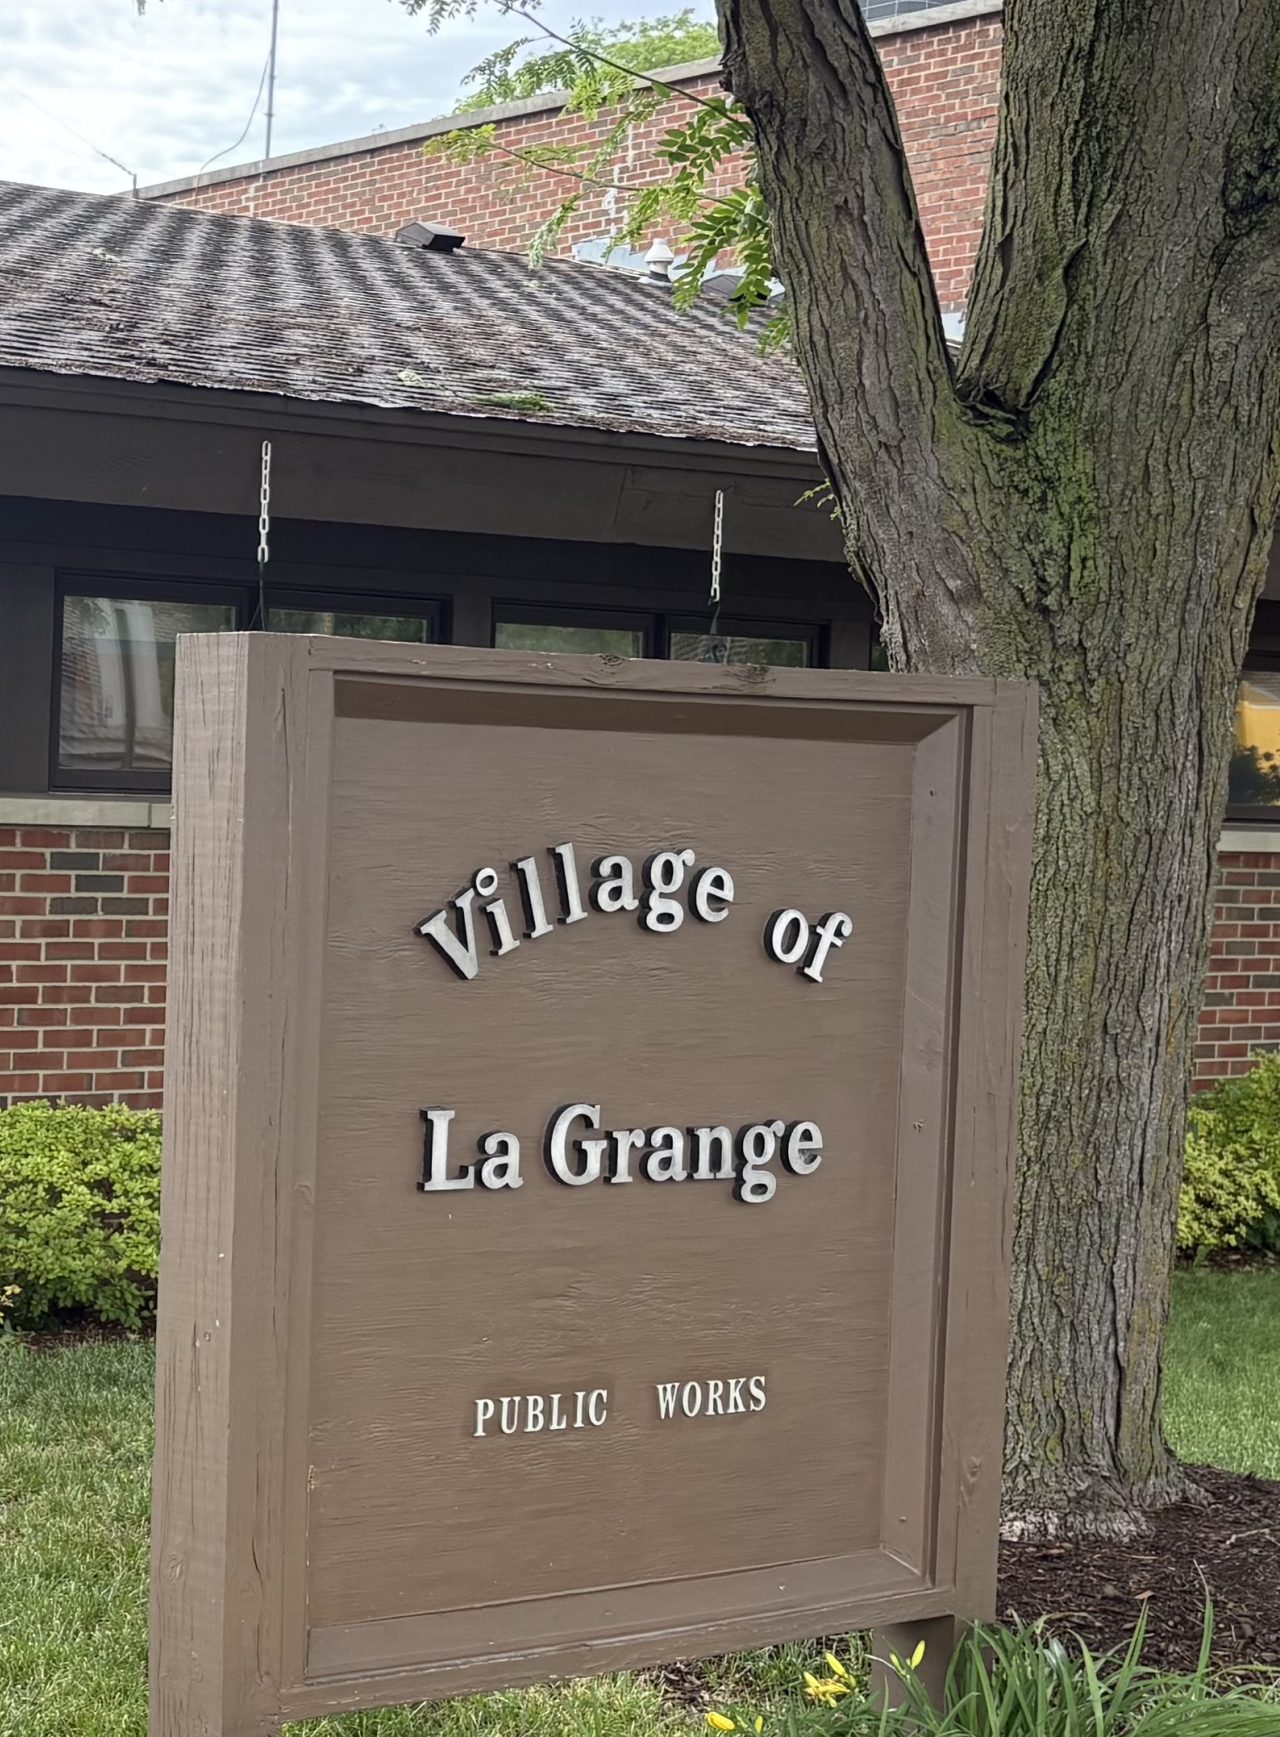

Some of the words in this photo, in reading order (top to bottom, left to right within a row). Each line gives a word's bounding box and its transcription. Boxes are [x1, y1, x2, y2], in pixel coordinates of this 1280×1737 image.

[416, 842, 735, 980] Village
[418, 1107, 523, 1191] La
[544, 1104, 823, 1203] Grange
[473, 1389, 608, 1437] PUBLIC
[656, 1375, 767, 1420] WORKS
